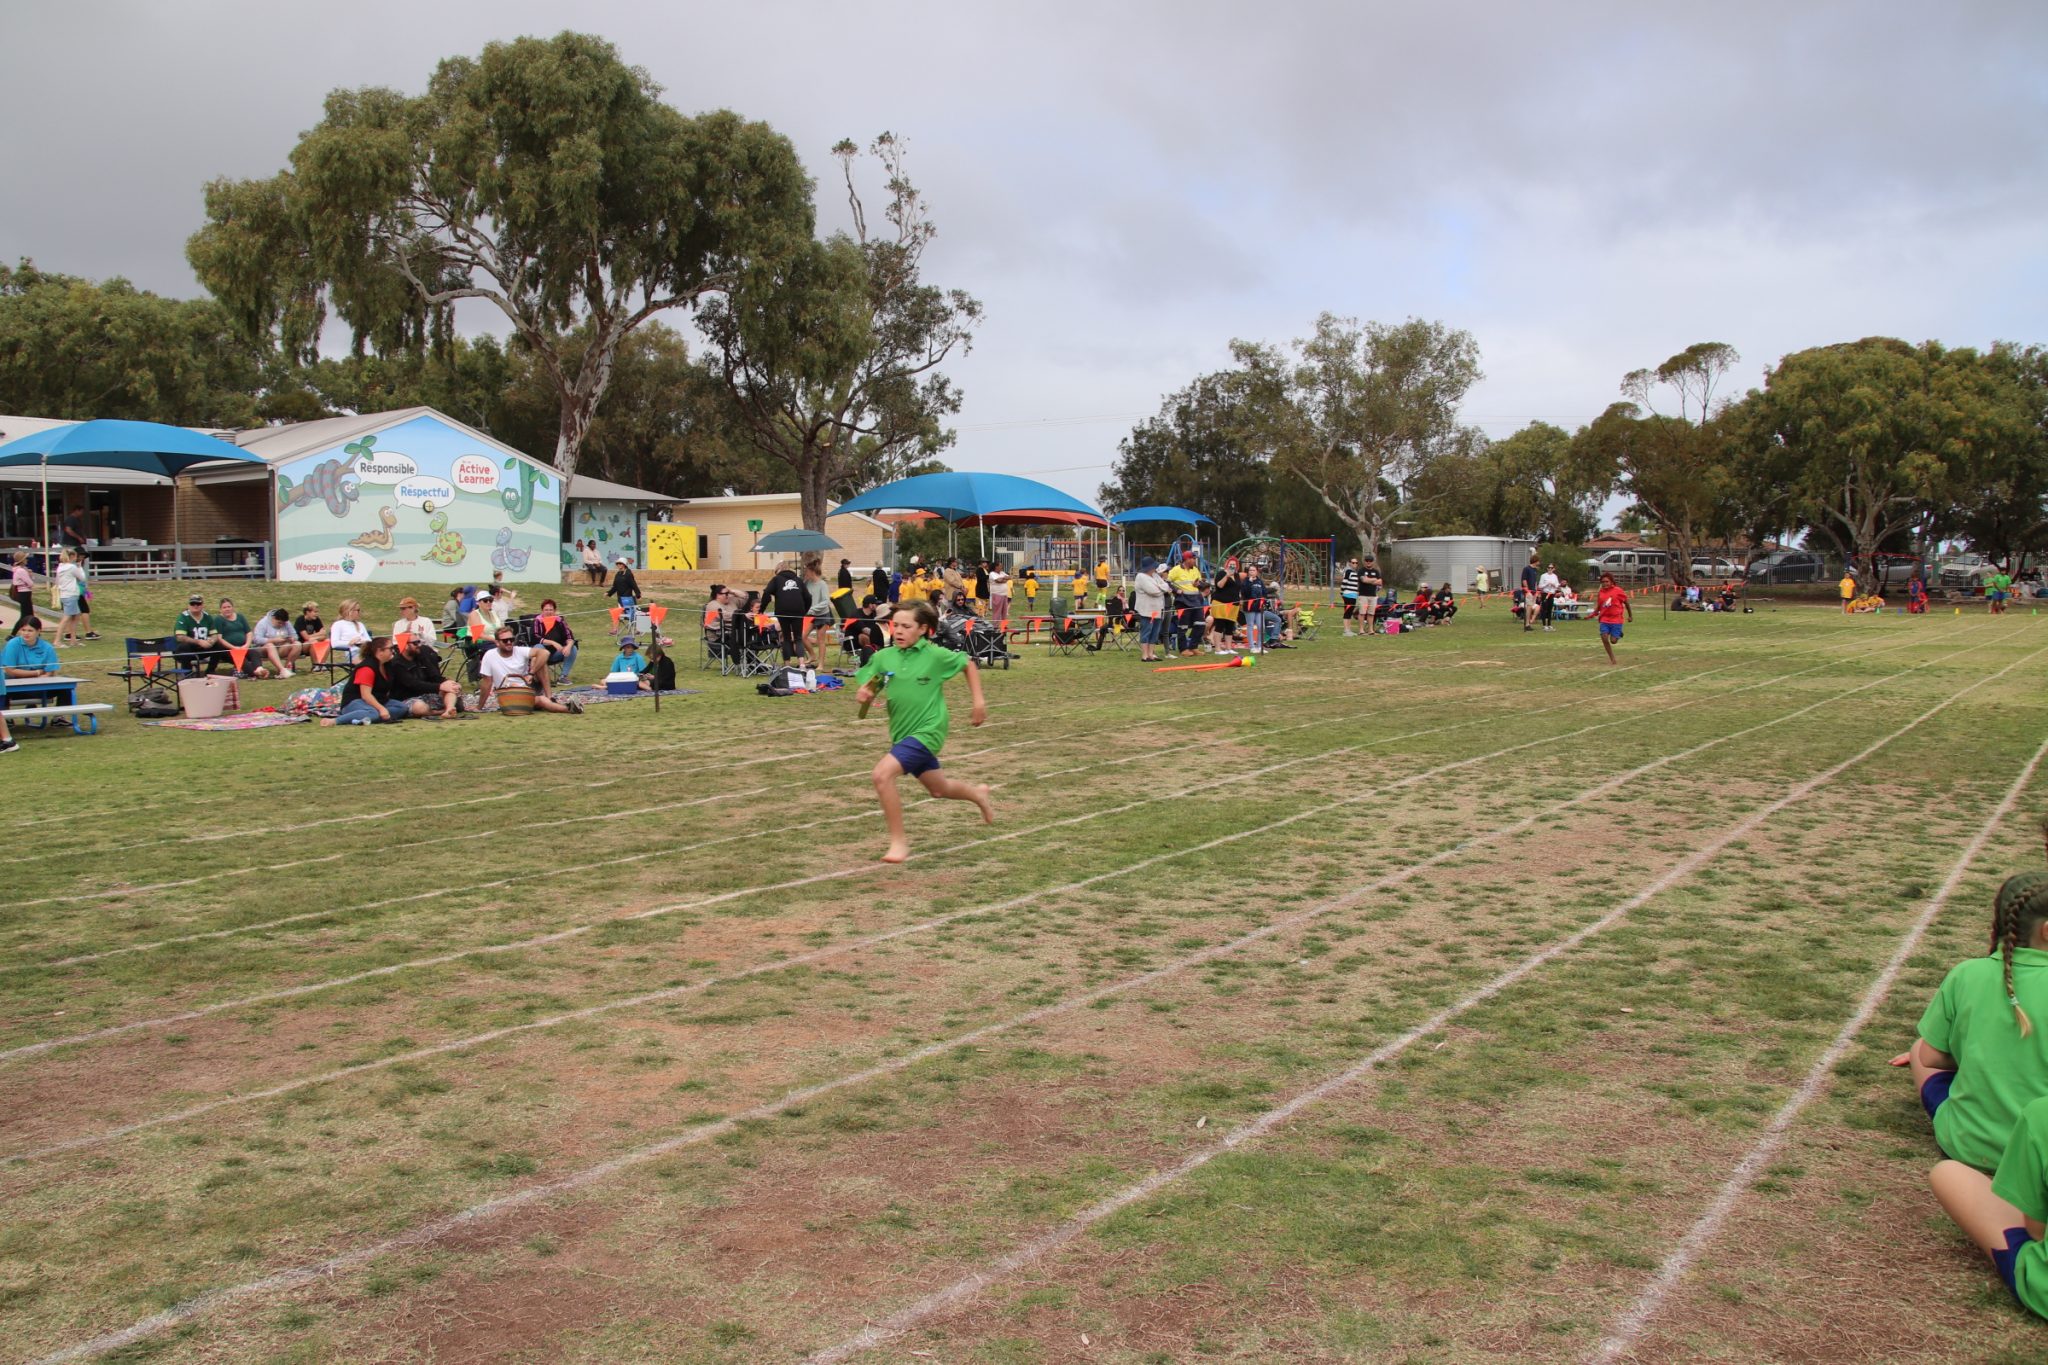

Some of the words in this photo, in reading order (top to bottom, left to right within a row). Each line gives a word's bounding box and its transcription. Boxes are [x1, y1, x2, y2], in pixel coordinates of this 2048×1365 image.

[360, 462, 415, 475] Responsible
[459, 463, 491, 474] Active
[458, 474, 495, 484] Learner
[400, 486, 450, 498] Respectful
[295, 562, 340, 573] Waggrakine
